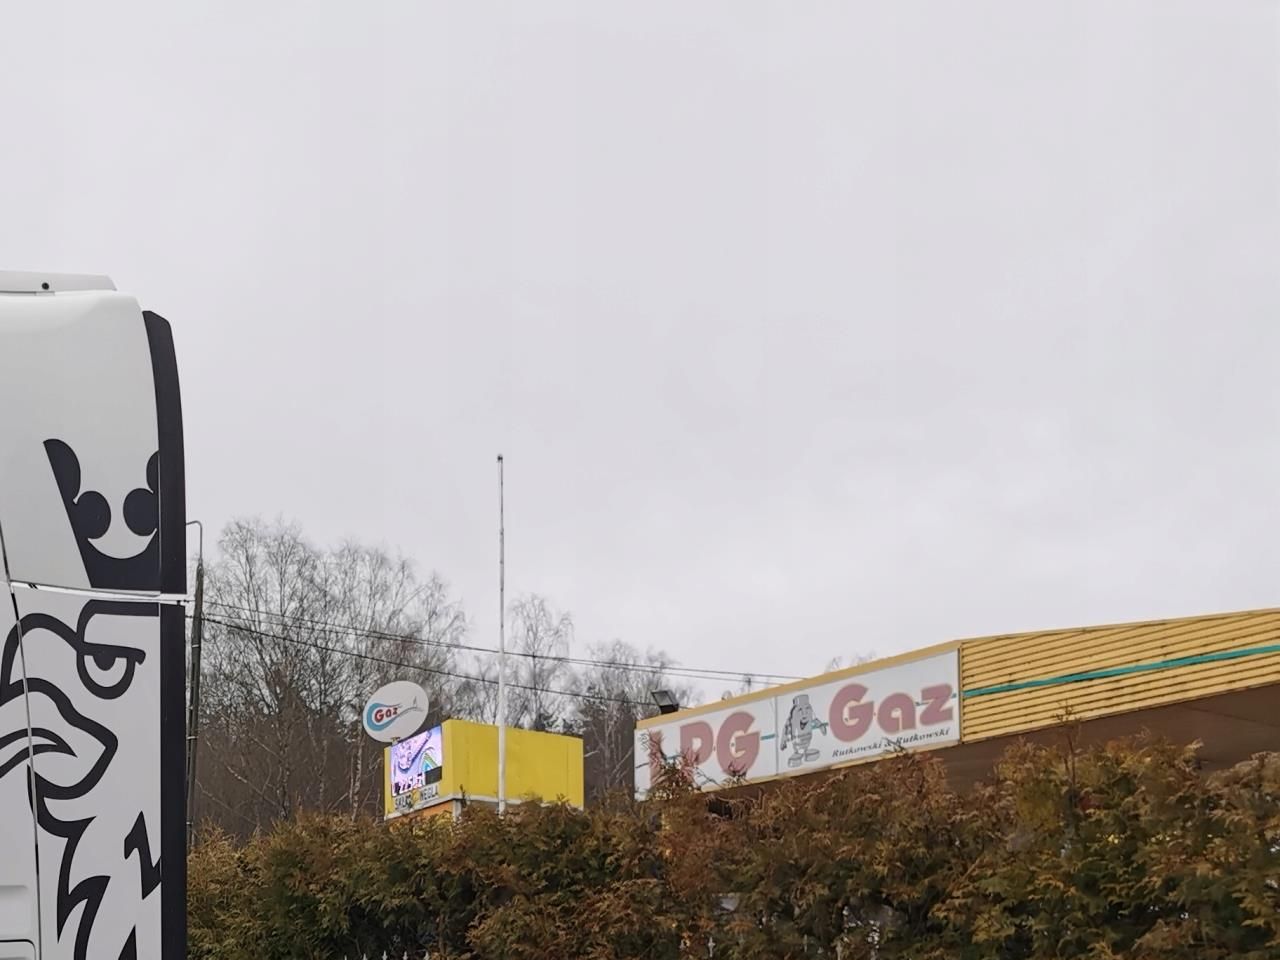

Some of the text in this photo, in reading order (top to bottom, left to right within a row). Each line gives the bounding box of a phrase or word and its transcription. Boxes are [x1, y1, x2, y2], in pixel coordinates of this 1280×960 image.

[374, 707, 399, 724] Gaz
[828, 682, 955, 743] Gaz
[832, 741, 883, 758] Rutkowski
[895, 727, 951, 747] Rutkowski
